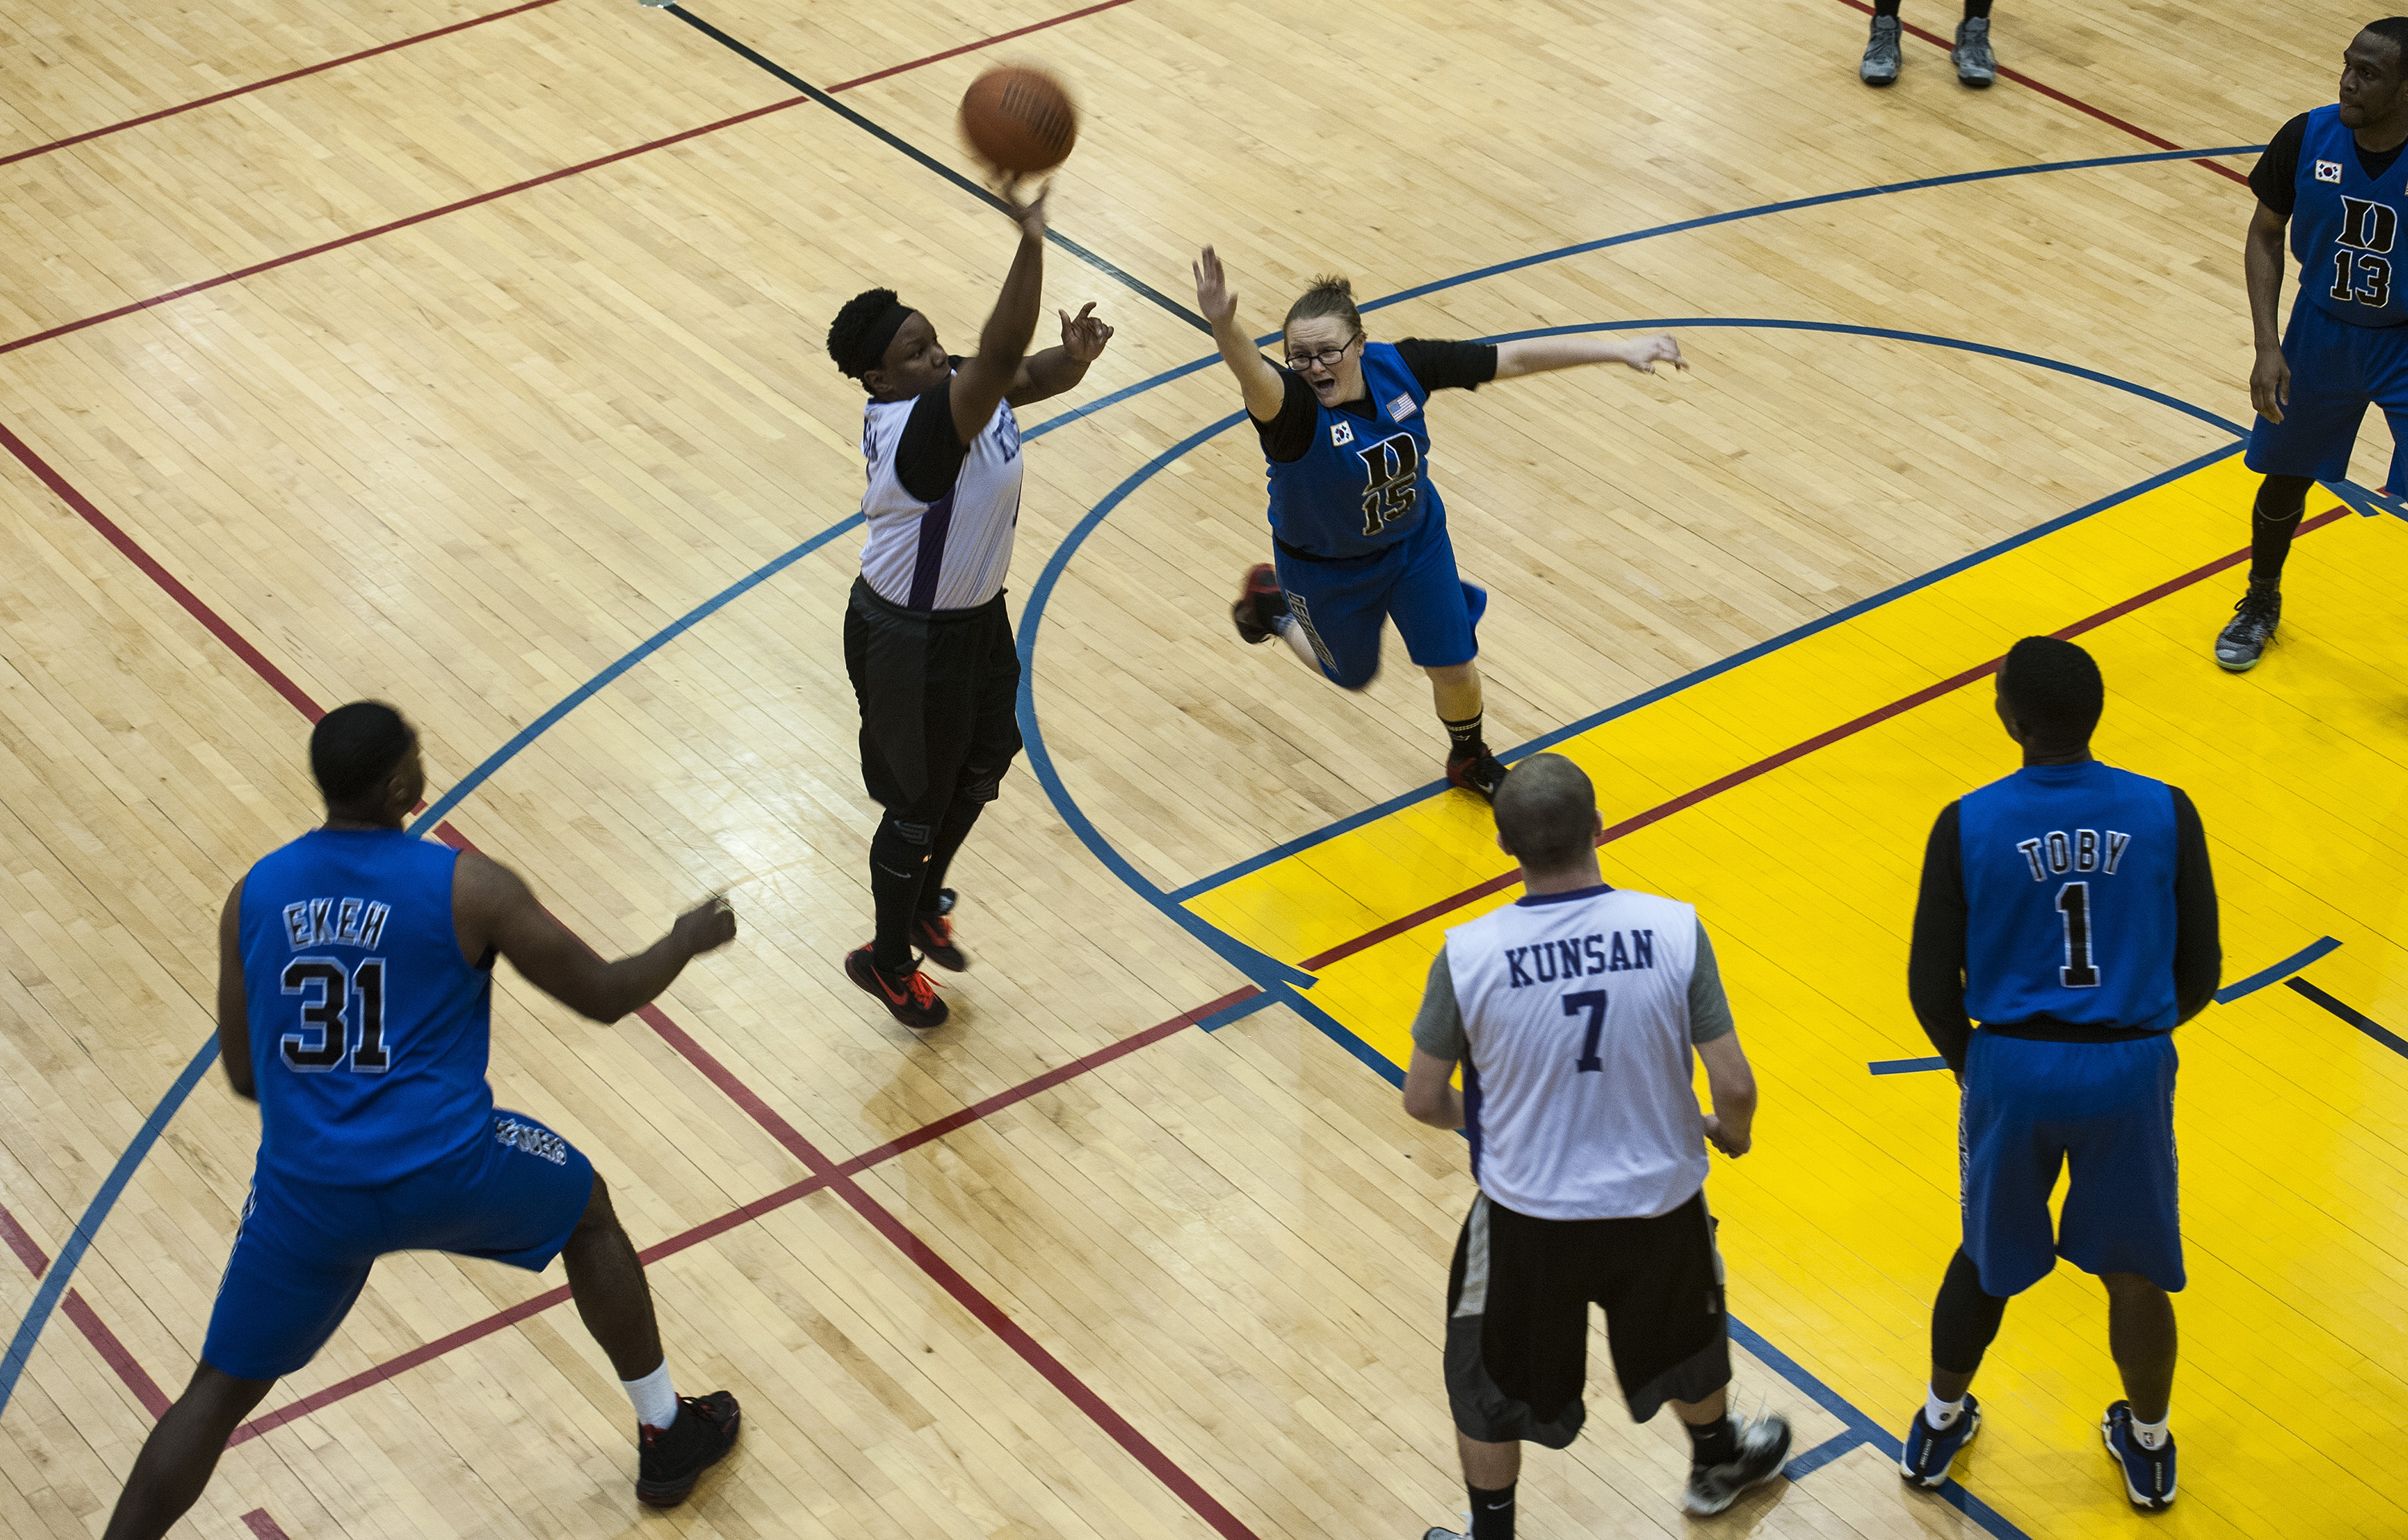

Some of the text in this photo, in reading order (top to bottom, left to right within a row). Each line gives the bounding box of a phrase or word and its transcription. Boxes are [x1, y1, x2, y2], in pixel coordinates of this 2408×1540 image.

[2334, 194, 2398, 254] D
[2329, 249, 2392, 308] 13
[1357, 432, 1418, 496] D
[1362, 473, 1416, 536] 15
[2015, 828, 2132, 882] TOBY
[283, 896, 392, 953] EKEH
[2055, 881, 2101, 988] 1
[1504, 929, 1653, 989] KUNSAN
[279, 955, 391, 1073] 31
[1561, 989, 1608, 1074] 7
